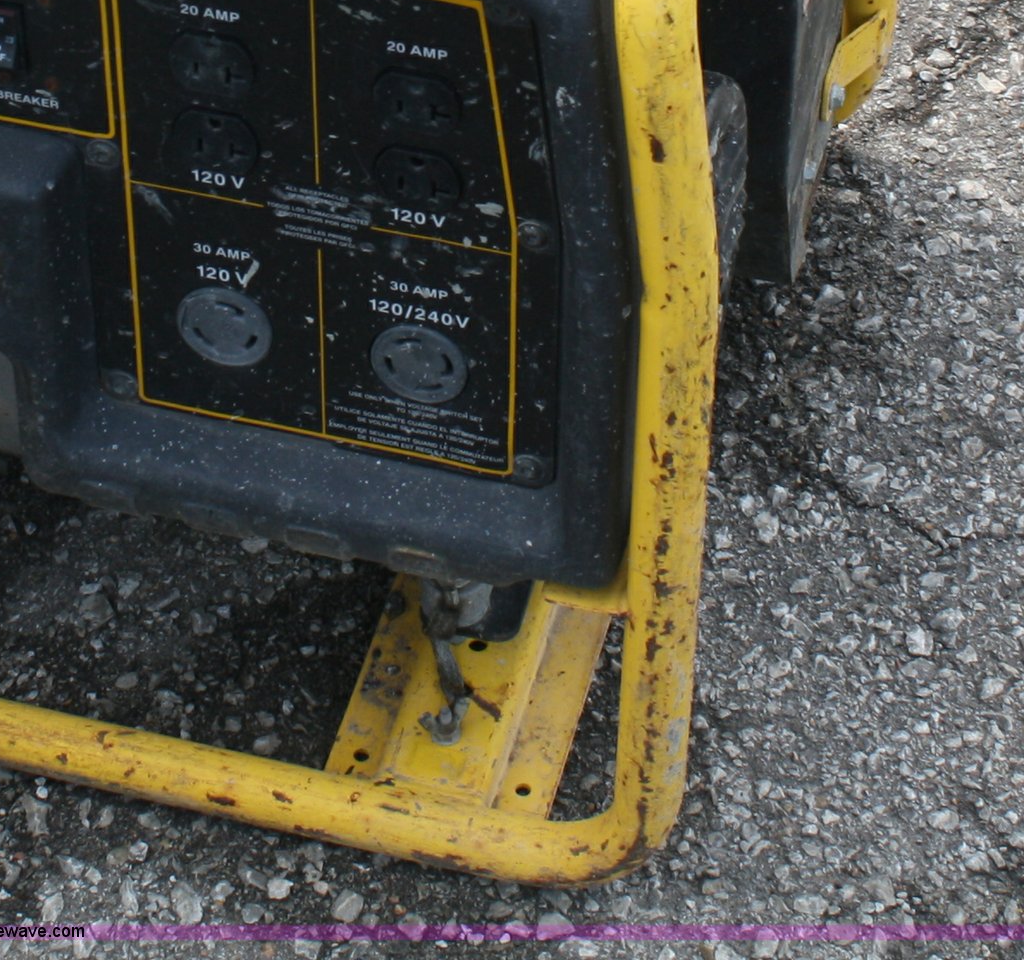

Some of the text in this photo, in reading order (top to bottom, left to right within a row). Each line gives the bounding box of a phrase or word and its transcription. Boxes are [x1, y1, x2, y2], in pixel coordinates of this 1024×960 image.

[179, 3, 240, 23] 20 AMP
[386, 41, 448, 60] 20 AMP
[192, 170, 245, 190] 120 V
[391, 208, 446, 229] 120 V
[193, 242, 251, 261] 30 AMP
[196, 265, 250, 285] 120 V
[390, 280, 449, 300] 30 AMP
[369, 299, 470, 329] 120/240V
[348, 390, 363, 398] USE
[334, 405, 361, 415] UTILICE
